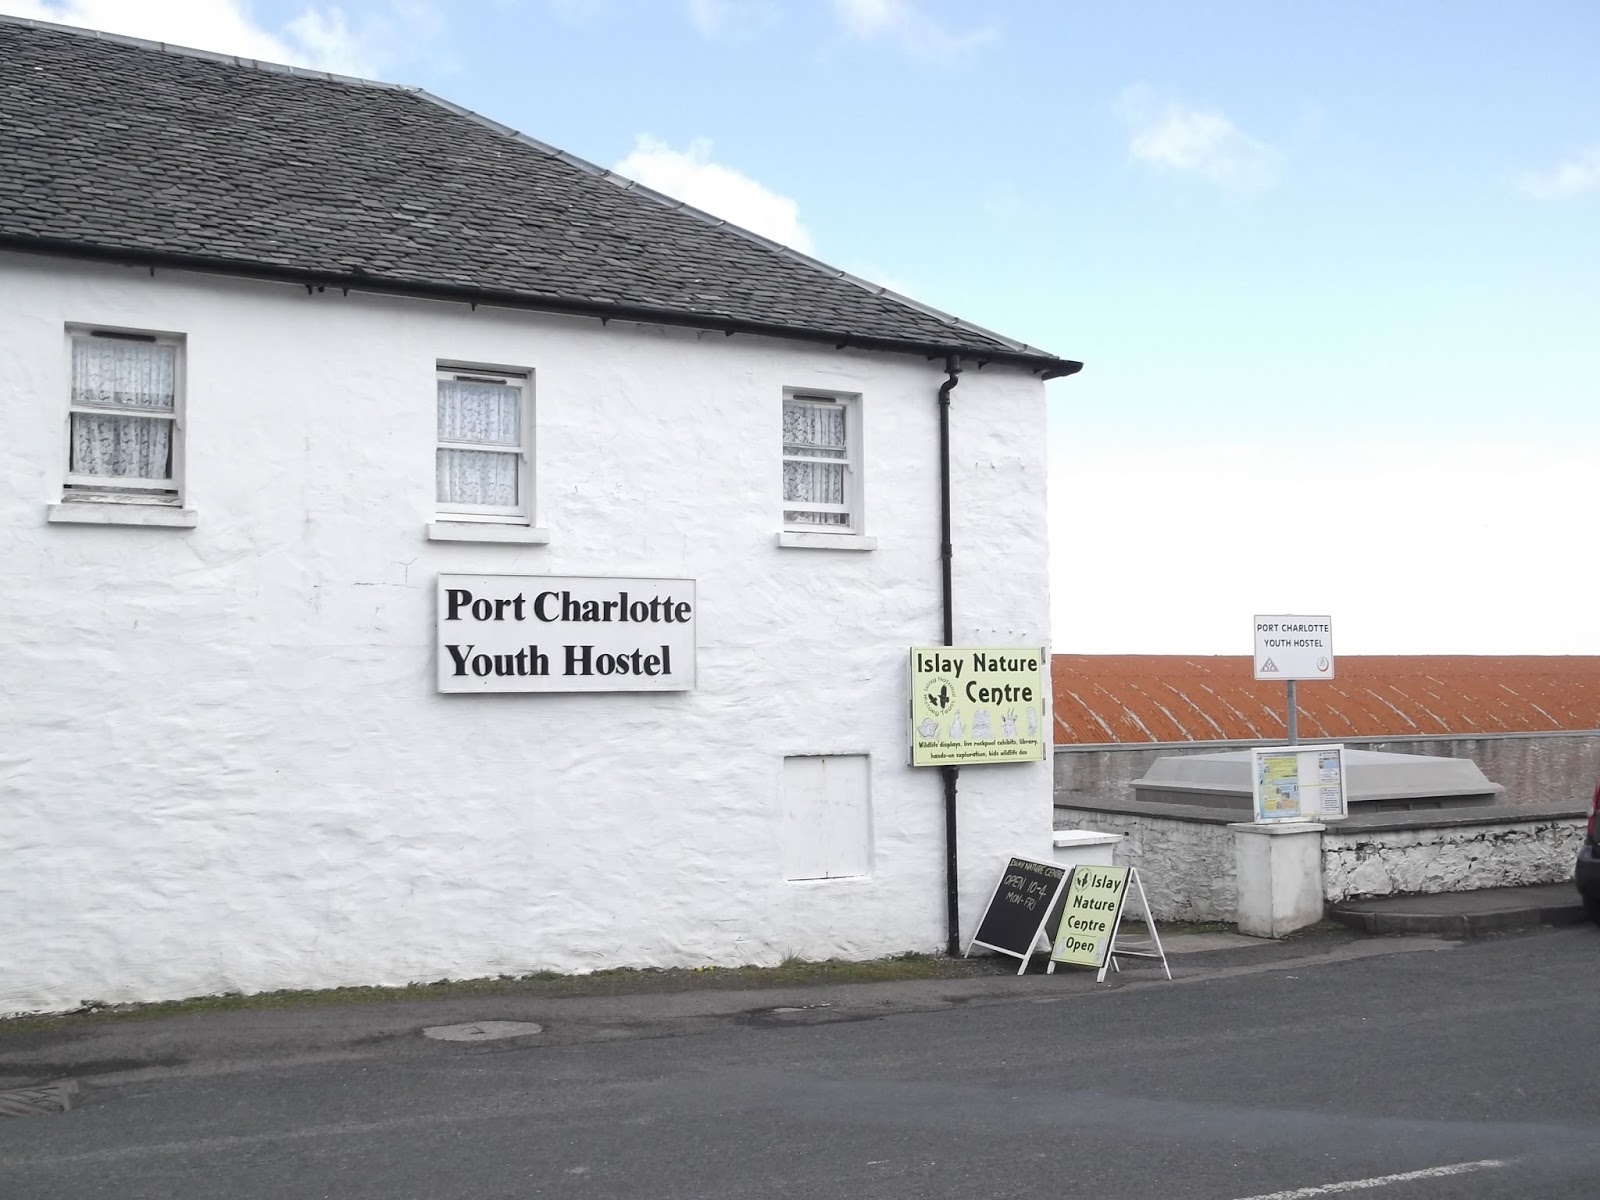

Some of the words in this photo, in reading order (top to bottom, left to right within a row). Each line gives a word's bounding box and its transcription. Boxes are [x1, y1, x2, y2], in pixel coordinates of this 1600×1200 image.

[445, 589, 526, 621] Port
[534, 591, 692, 623] Charlotte
[1257, 624, 1279, 632] PORT
[1281, 624, 1329, 632] CHARLOTTE
[1264, 639, 1291, 647] YOUTH
[1294, 639, 1323, 647] HOSTEL
[445, 645, 550, 676] Youth
[562, 645, 672, 676] Hostel
[918, 653, 964, 678] Islay
[973, 653, 1037, 672] Nature
[966, 681, 1032, 706] Centre
[939, 740, 963, 749] displays,
[955, 751, 987, 759] exploration,
[1009, 858, 1026, 869] ISLAY
[1024, 862, 1047, 875] NATURE
[1004, 874, 1027, 891] OPEN
[1026, 880, 1048, 900] 10-4
[1091, 874, 1122, 893] Islay
[1005, 891, 1037, 911] MON-FRI
[1073, 894, 1115, 912] Nature
[1067, 915, 1106, 932] Centre
[1066, 936, 1095, 953] Open
